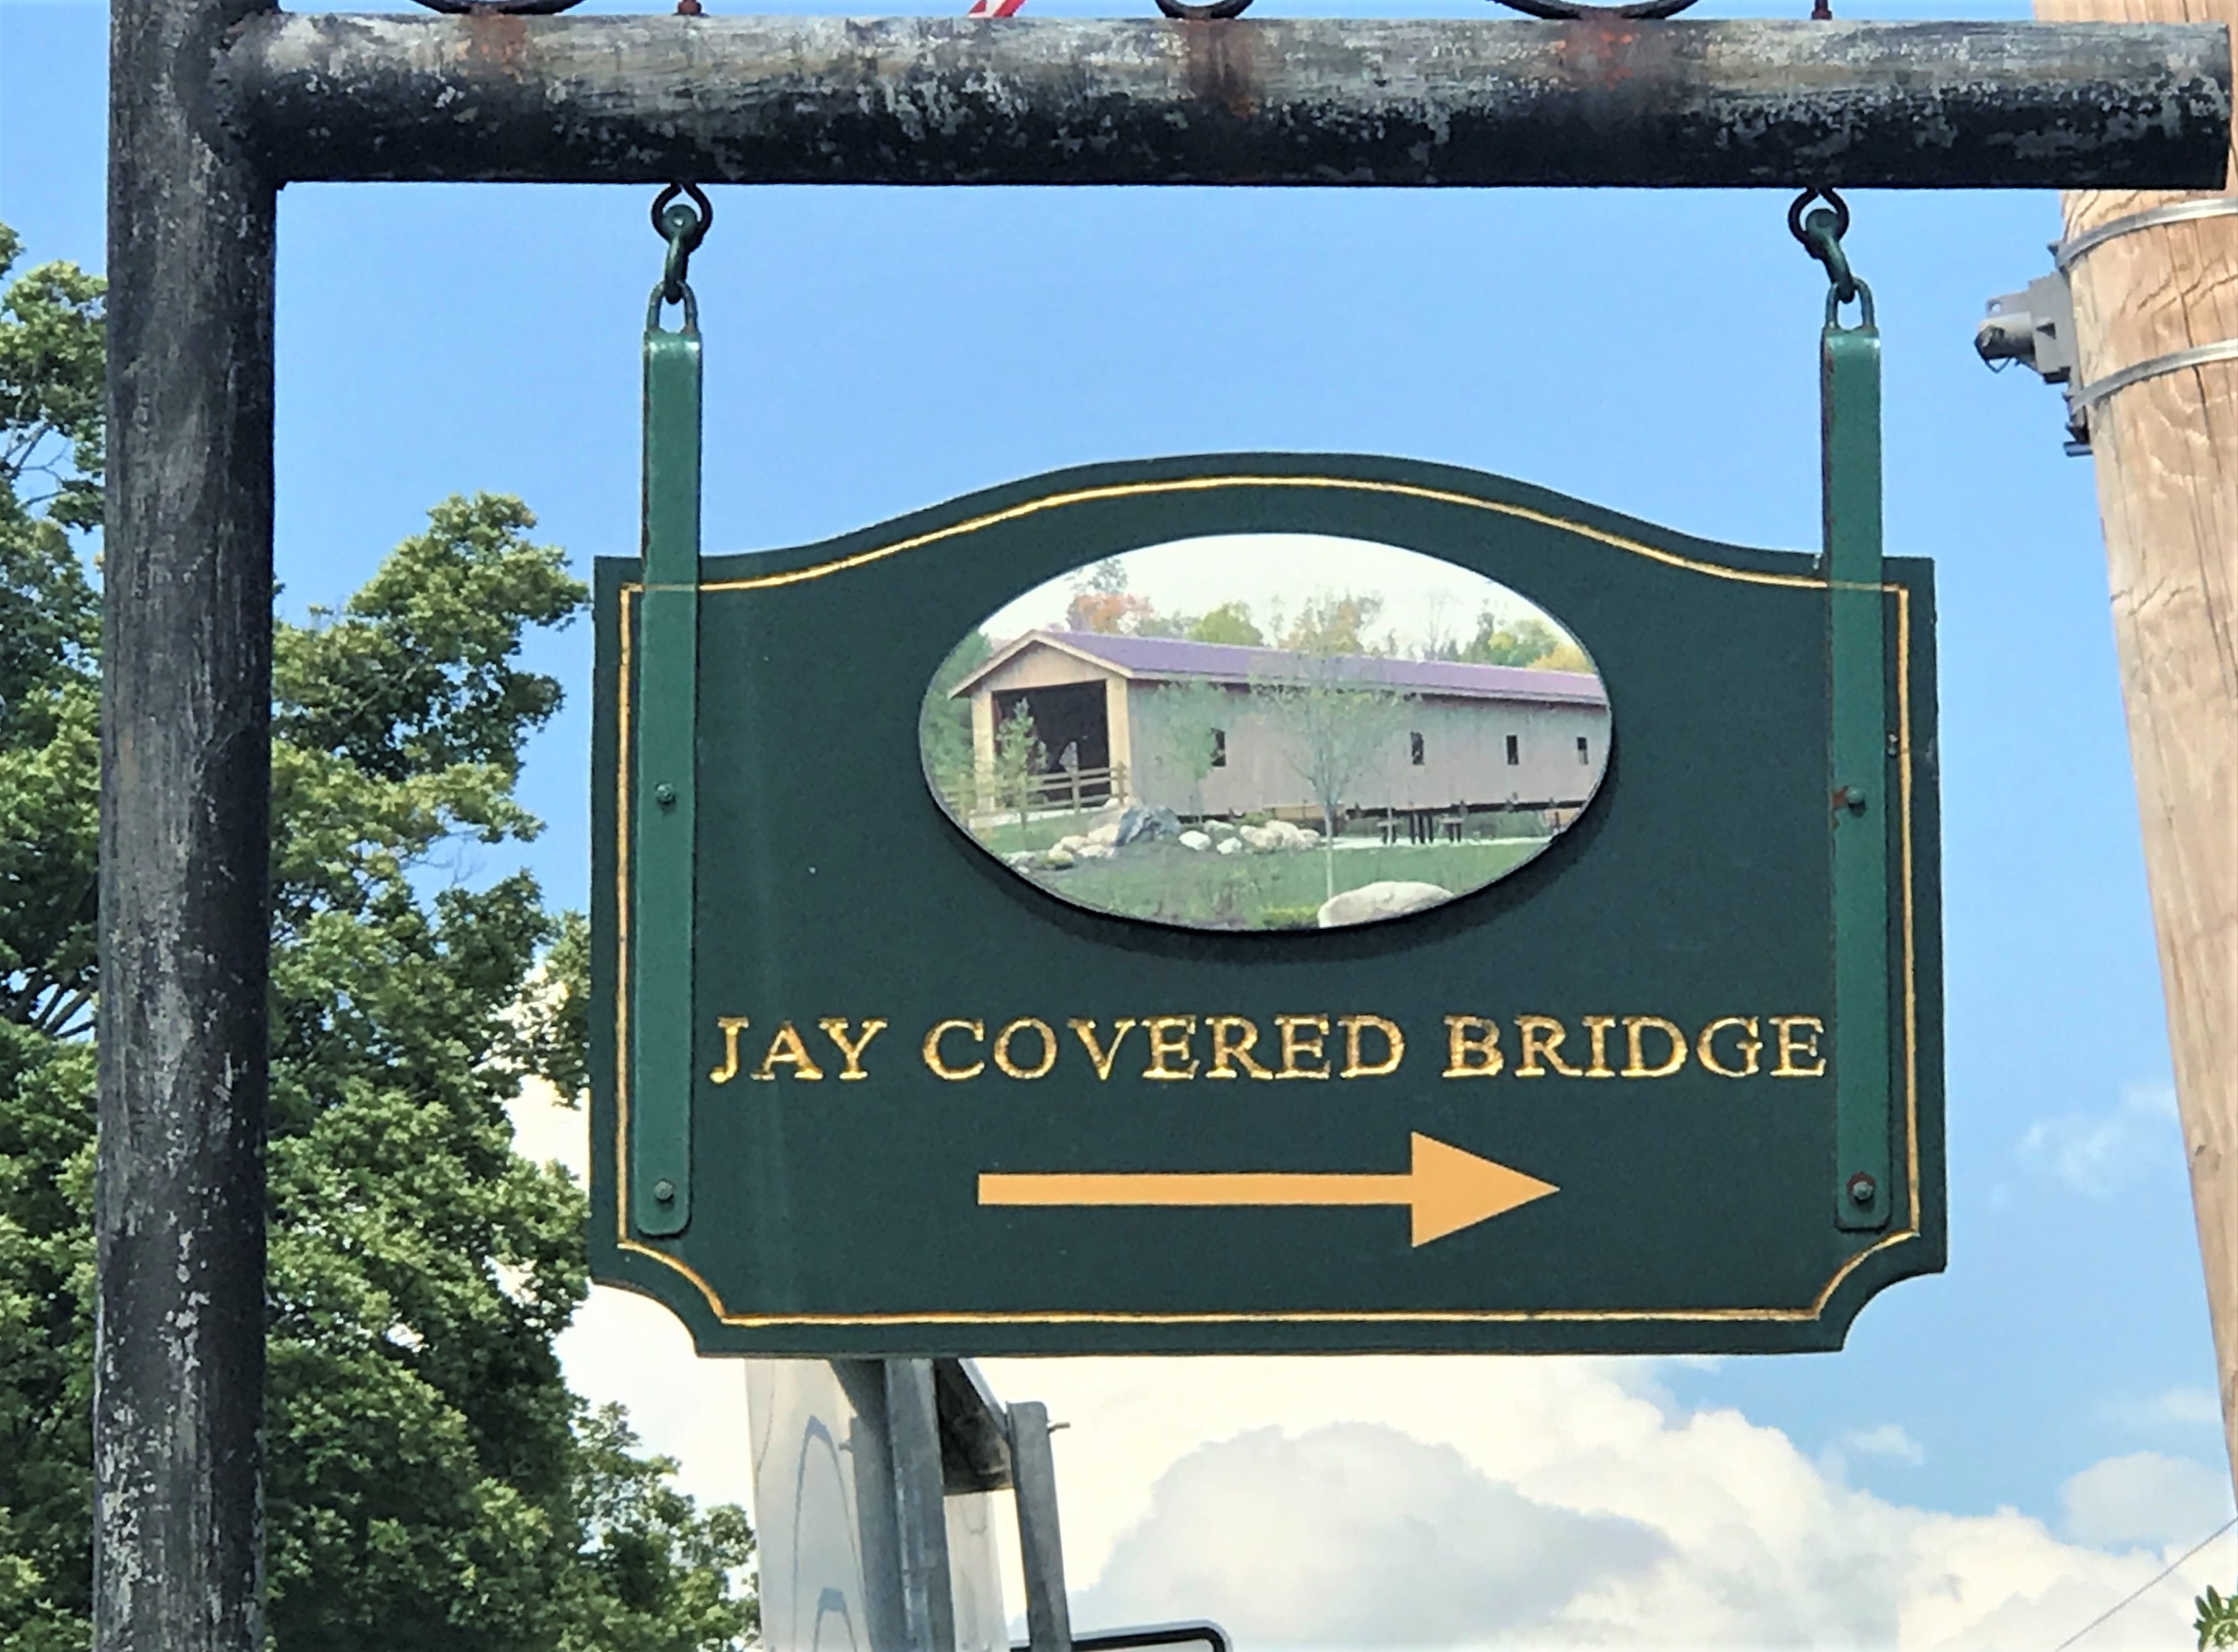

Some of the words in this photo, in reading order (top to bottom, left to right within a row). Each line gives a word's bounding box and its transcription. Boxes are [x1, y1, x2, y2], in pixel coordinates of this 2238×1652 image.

[709, 1016, 887, 1084] JAY
[922, 1015, 1405, 1081] COVERED
[1442, 1015, 1827, 1079] BRIDGE
